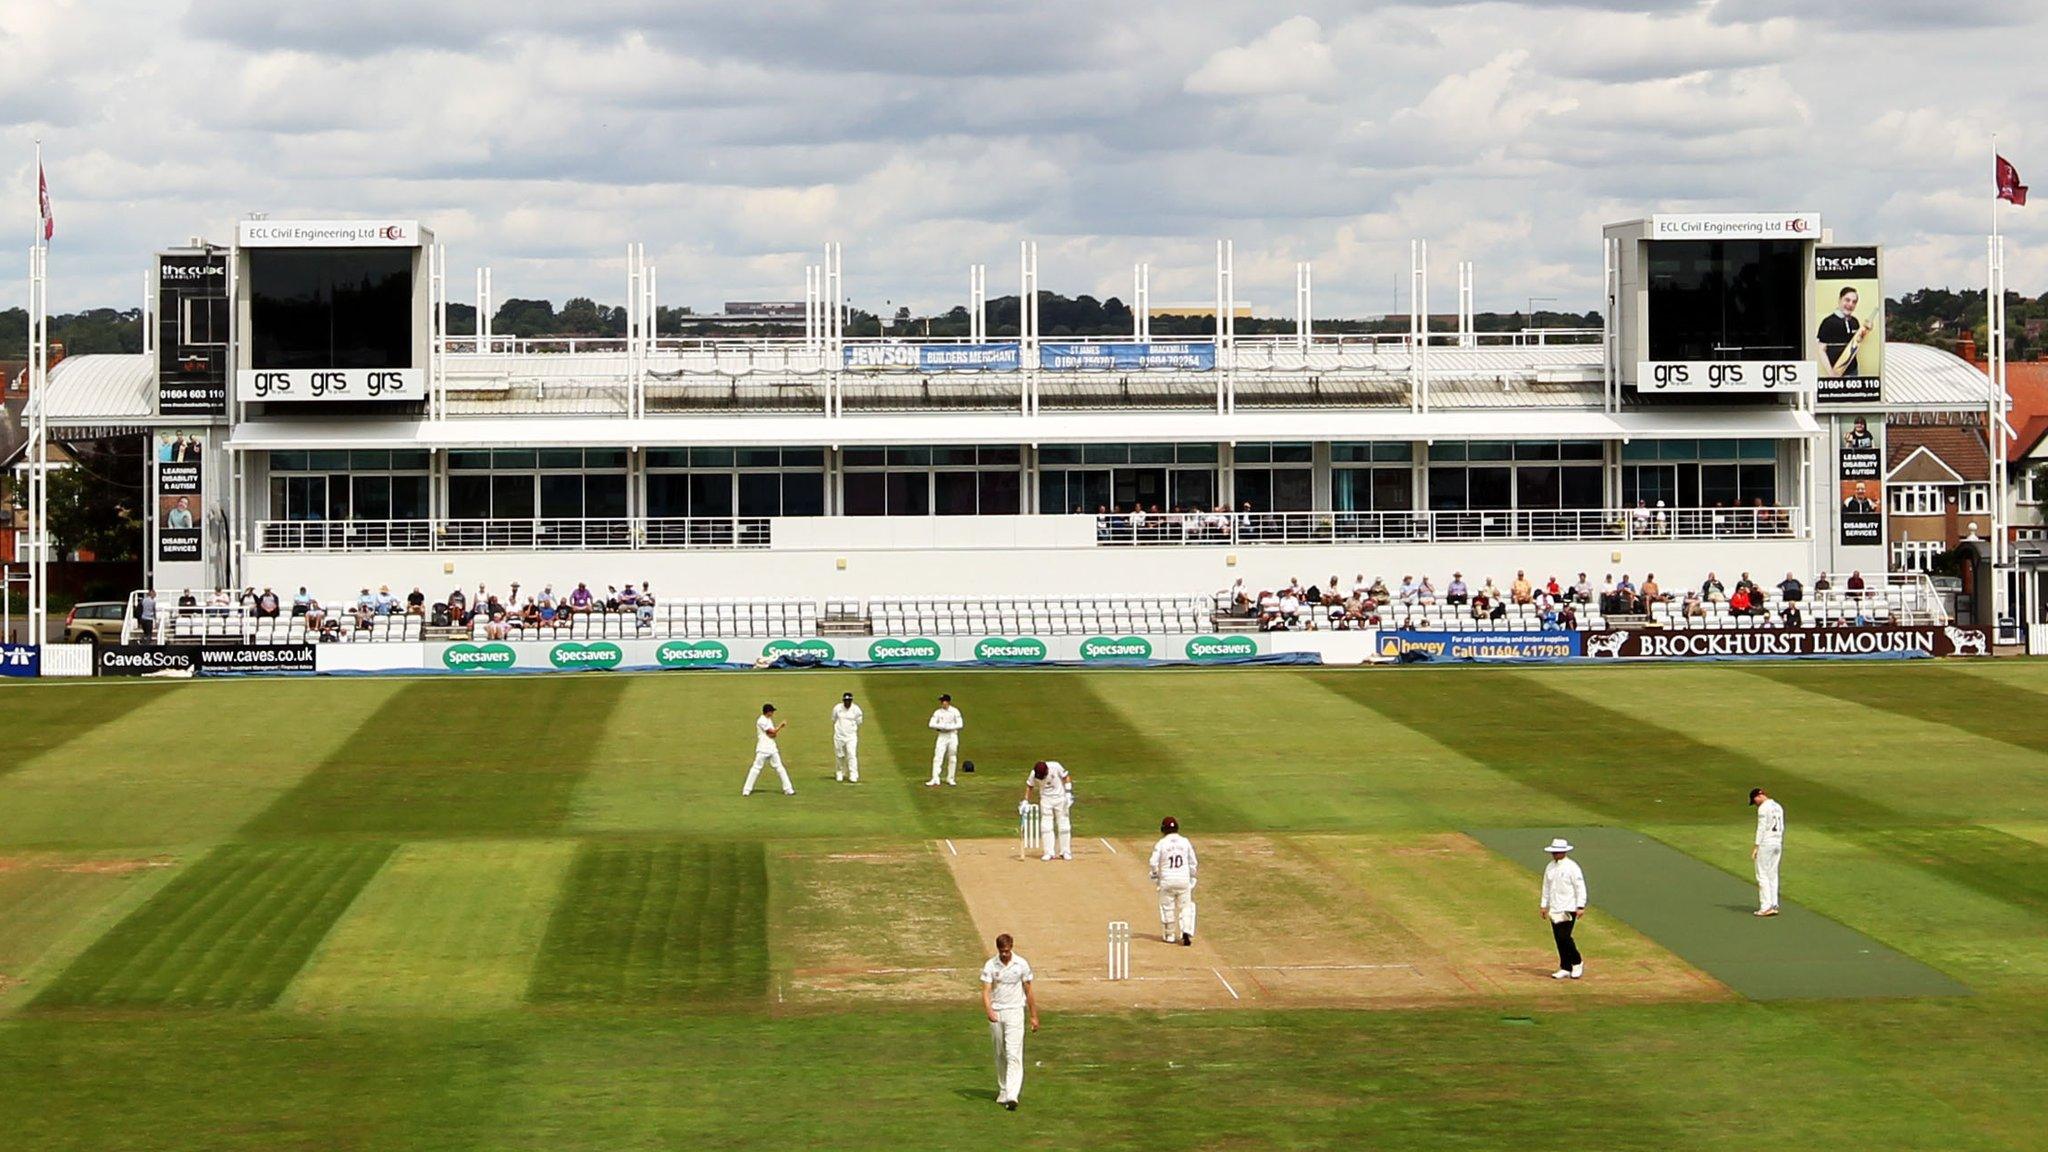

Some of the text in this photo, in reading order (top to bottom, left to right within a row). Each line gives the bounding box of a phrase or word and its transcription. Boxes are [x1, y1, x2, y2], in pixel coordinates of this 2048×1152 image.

[249, 228, 375, 241] ECL Civil Engineering Ltd
[1660, 221, 1781, 234] ECL Civil Engineering Ltd
[1816, 256, 1876, 267] the cube
[162, 265, 224, 275] the cube
[849, 347, 1016, 364] JEWSON BUILDERS MERCHANT
[1654, 364, 1797, 388] grs grs grs
[255, 372, 403, 397] grs grs grs
[1818, 380, 1879, 389] 01604 603 110
[160, 390, 225, 399] 01604 603 110
[980, 643, 1041, 657] Specsavers
[1086, 641, 1147, 656] Specsavers
[1192, 640, 1253, 655] Specsavers
[1640, 631, 1935, 656] BROCKHURST LIMOUSIN
[202, 646, 313, 662] www.caves.co.uk
[449, 651, 510, 664] Specsavers
[555, 648, 617, 662] Specsavers
[662, 646, 723, 661] Specsavers
[875, 645, 935, 658] Specsavers
[1452, 645, 1570, 657] Call 01604 417930
[103, 651, 189, 666] Cave&Sons
[1168, 854, 1183, 869] 10
